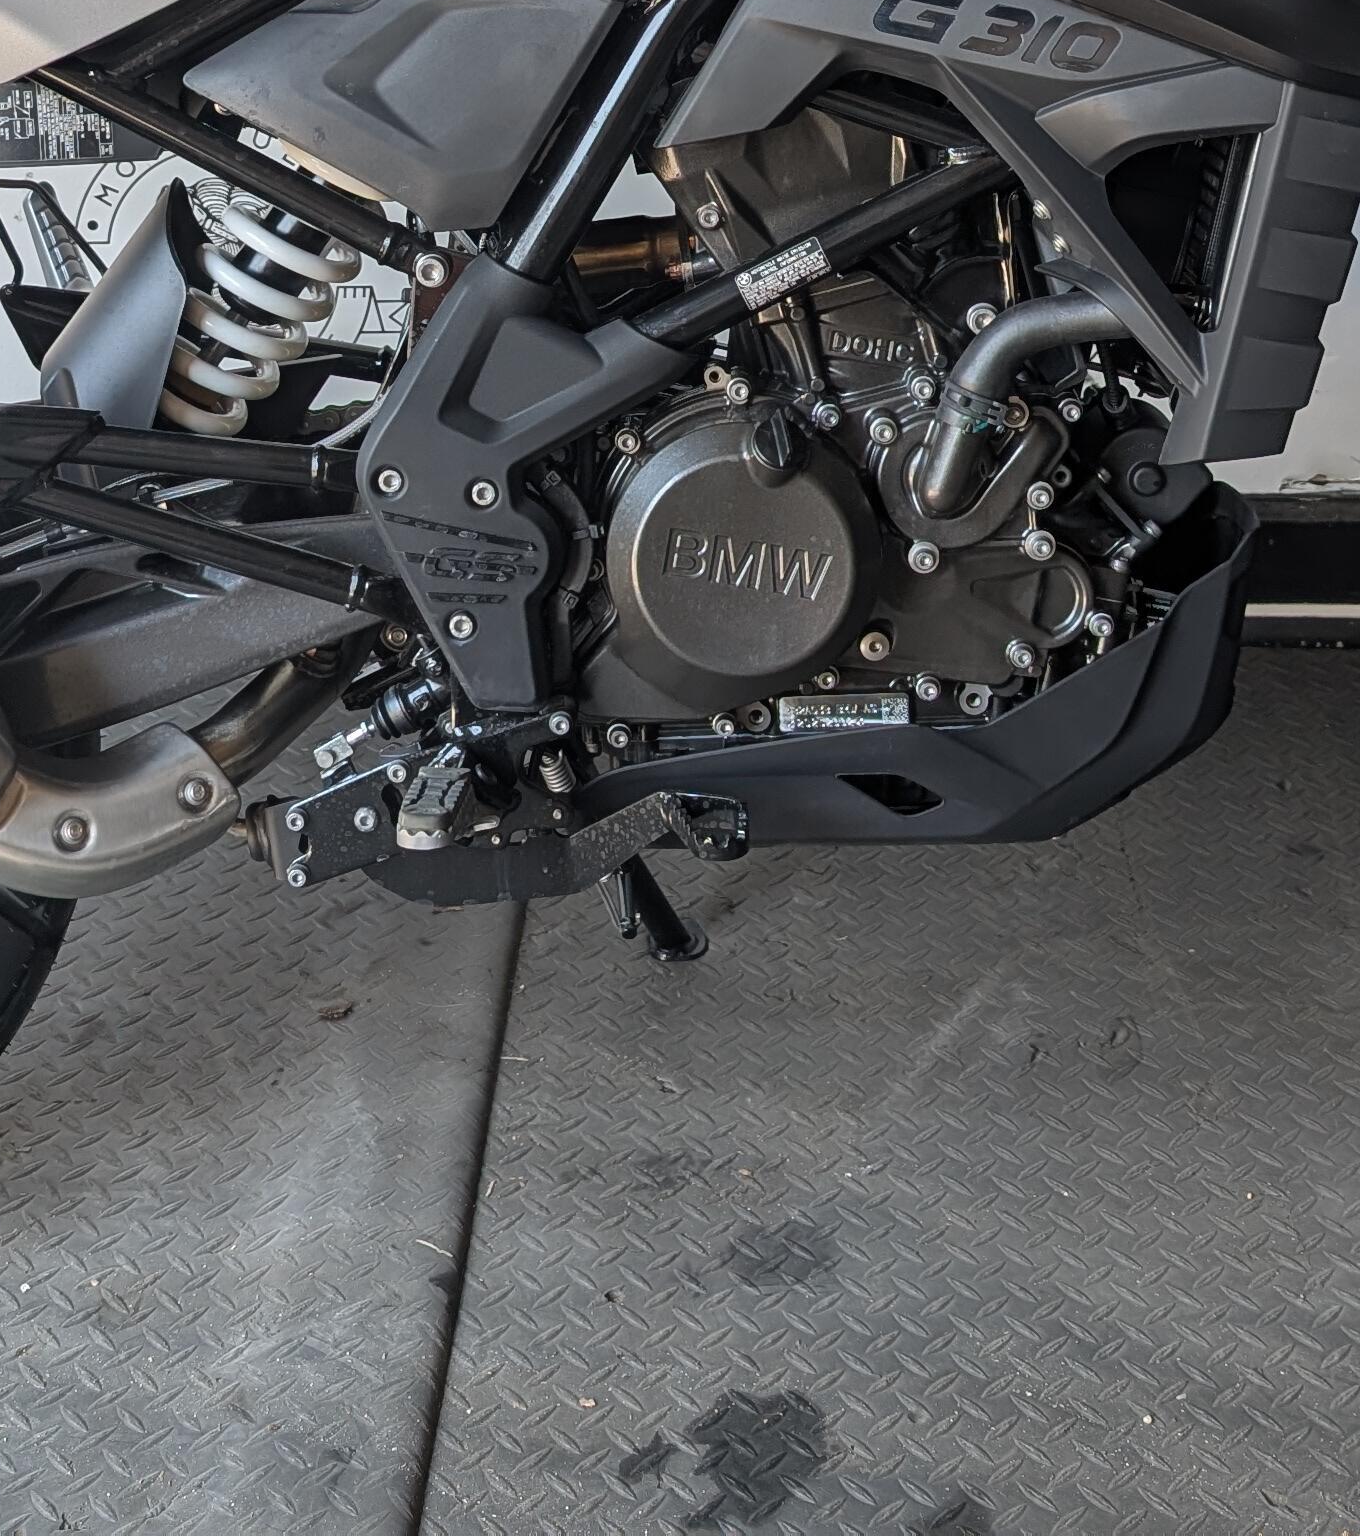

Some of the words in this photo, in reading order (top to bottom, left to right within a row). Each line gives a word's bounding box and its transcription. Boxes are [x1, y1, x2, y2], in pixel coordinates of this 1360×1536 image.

[958, 3, 1124, 74] 310
[831, 330, 915, 364] DOHC
[662, 527, 834, 601] BMW
